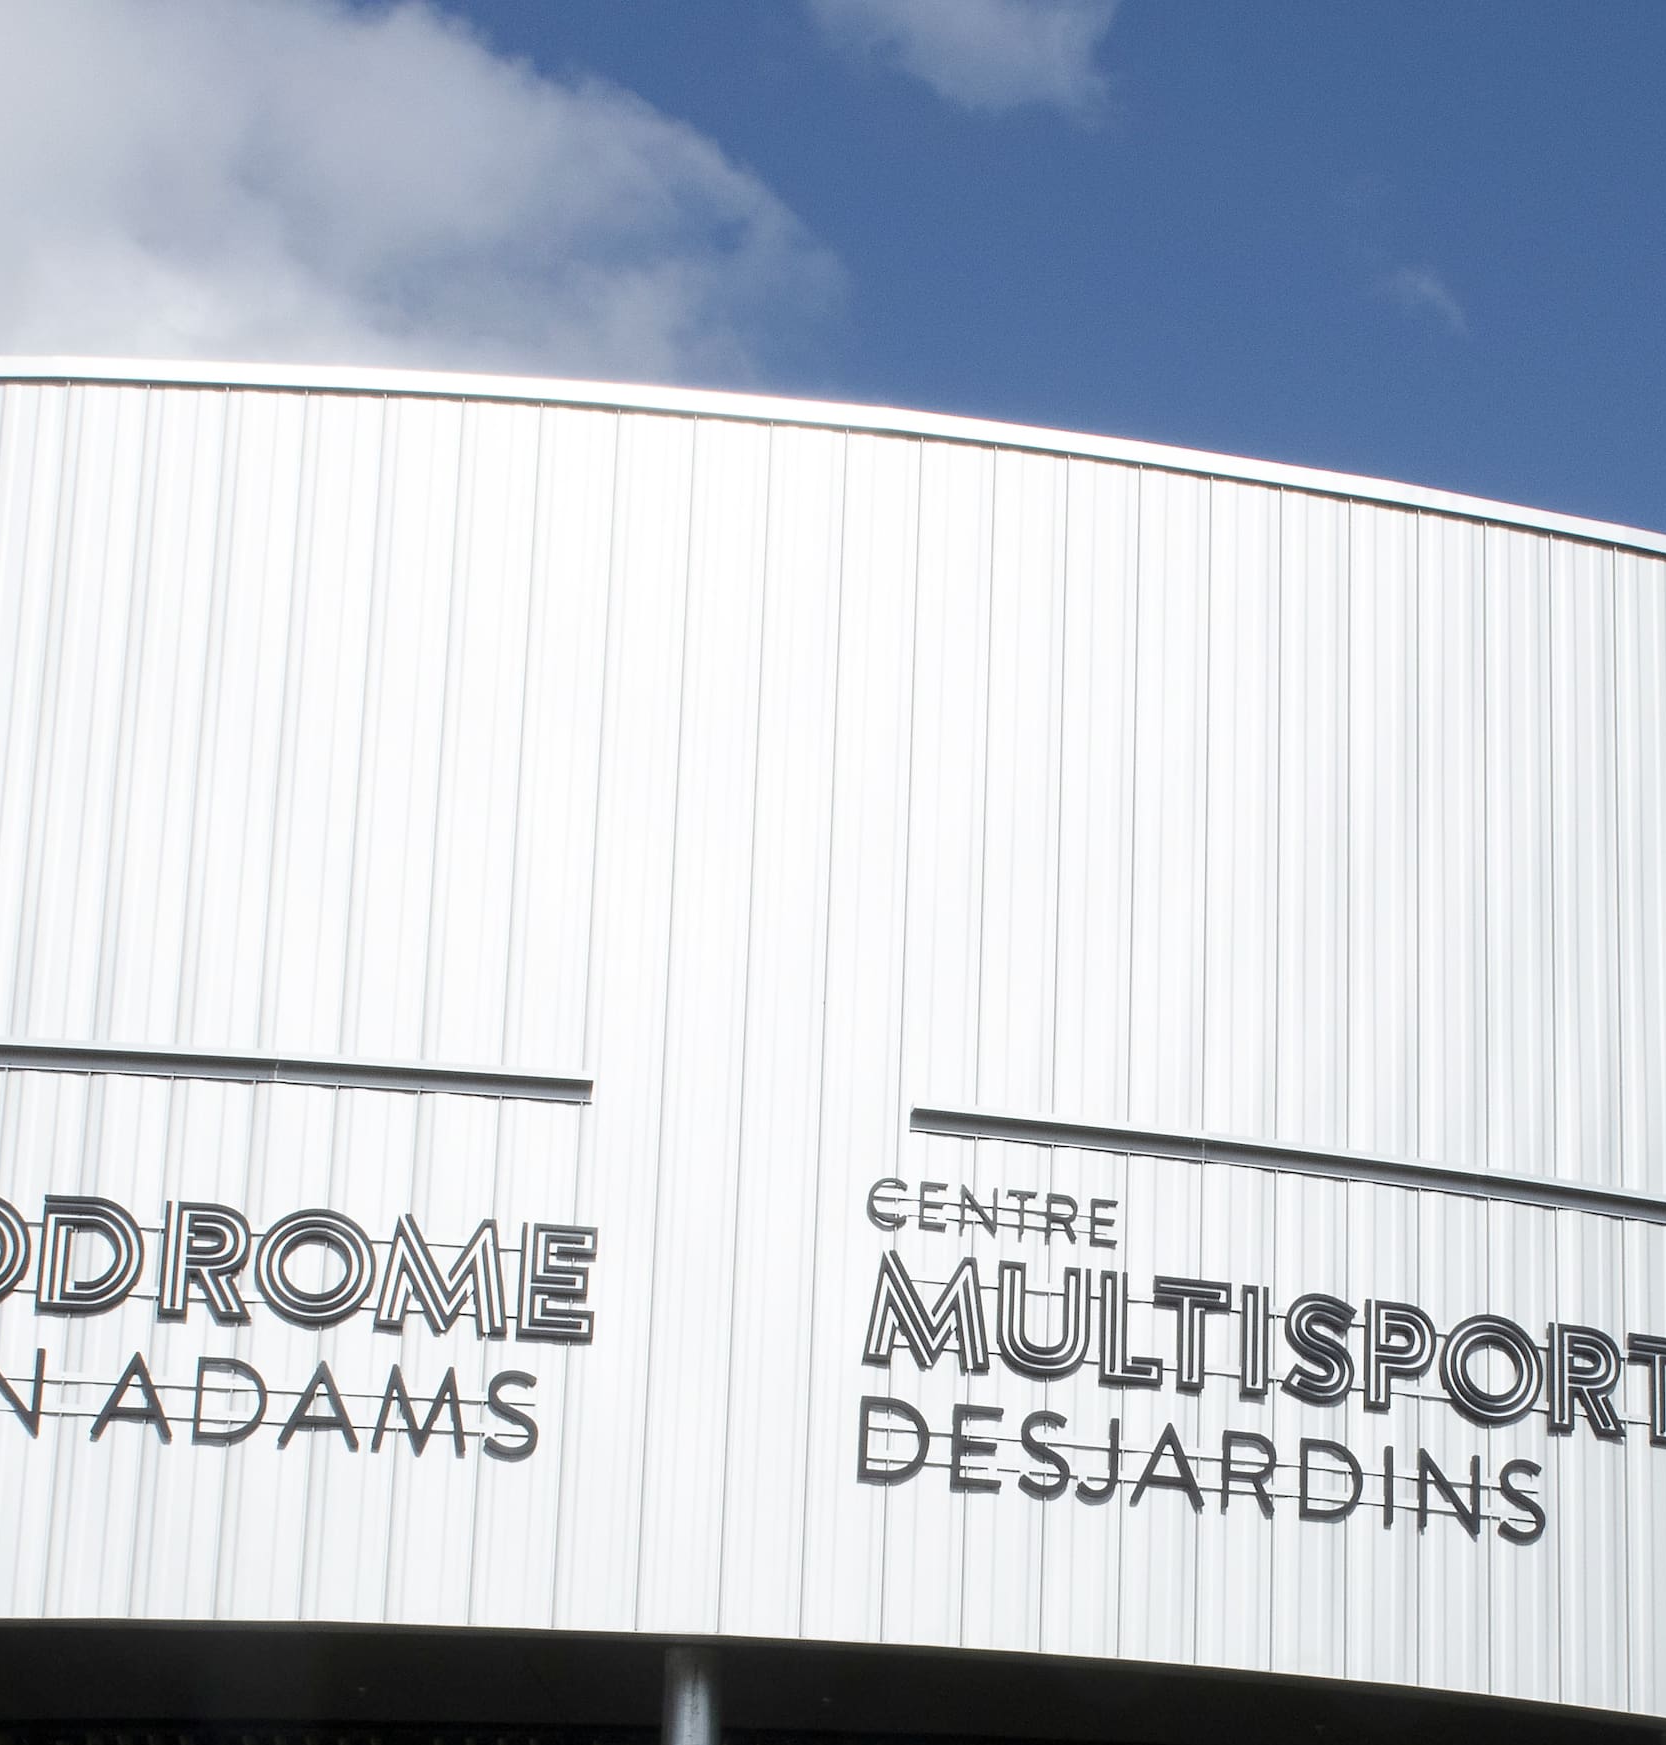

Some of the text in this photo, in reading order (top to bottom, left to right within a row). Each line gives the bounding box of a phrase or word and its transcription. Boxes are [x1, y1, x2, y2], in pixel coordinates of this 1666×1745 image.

[867, 1177, 1118, 1248] CENTRE
[88, 1350, 539, 1459] ADAMS
[856, 1396, 1547, 1546] DESJARDINS
